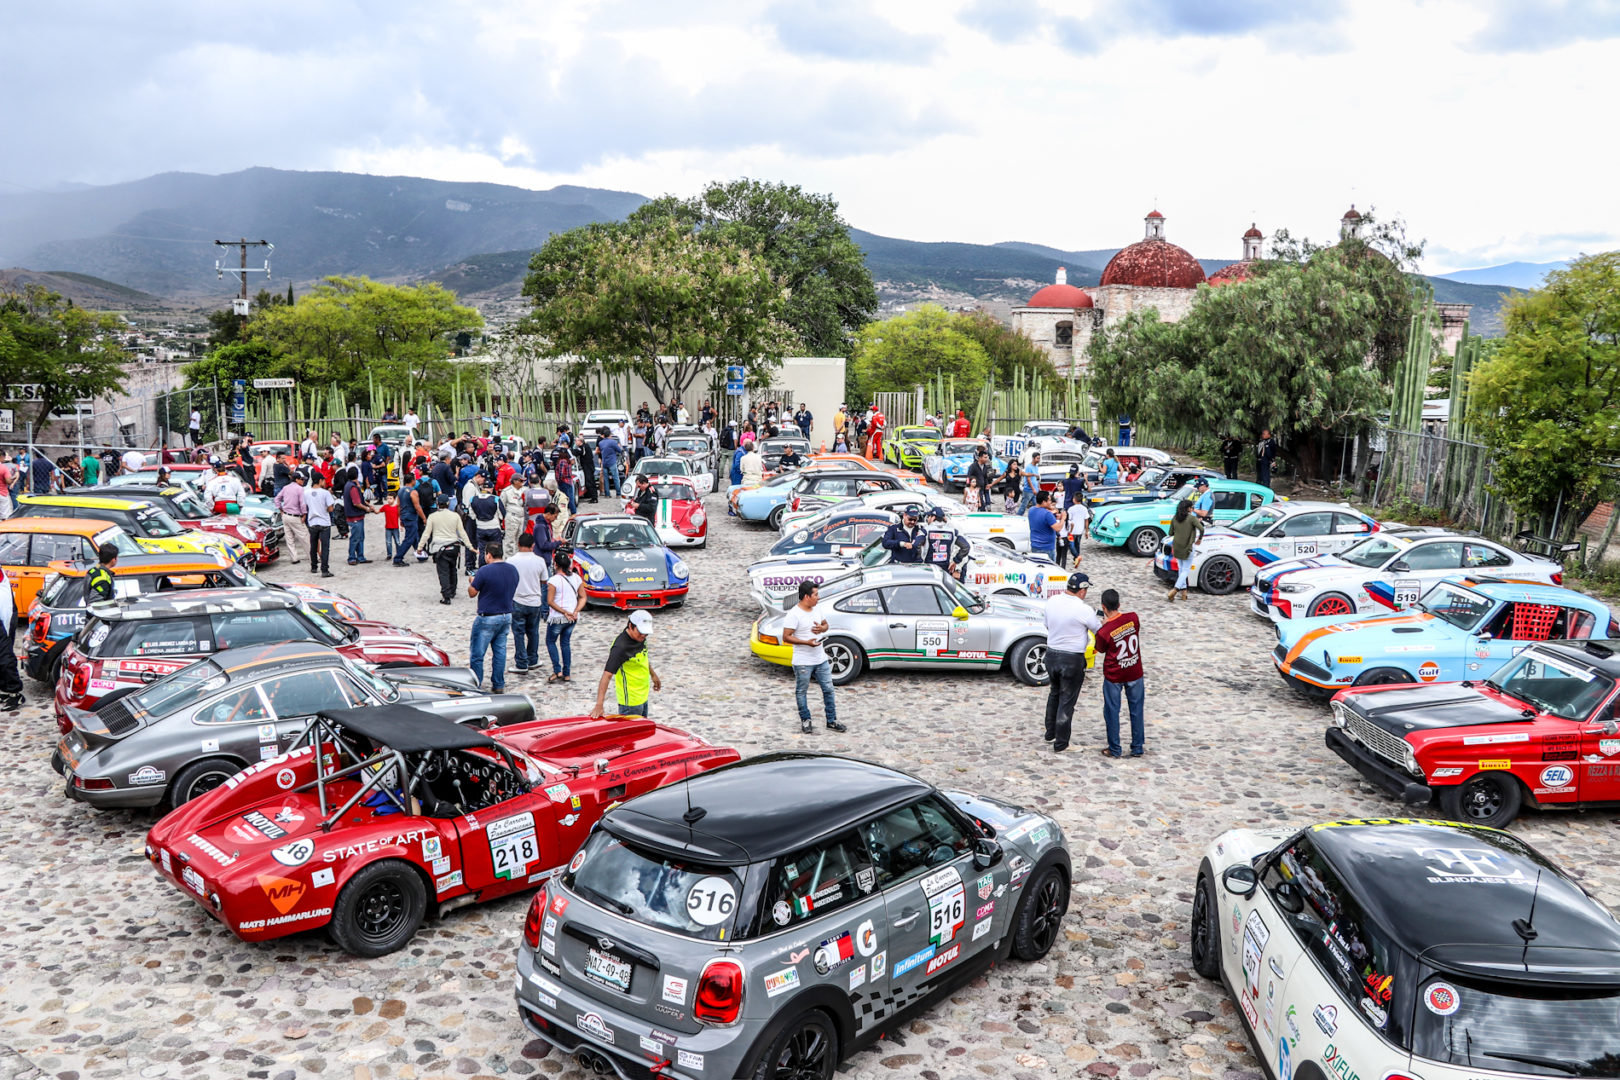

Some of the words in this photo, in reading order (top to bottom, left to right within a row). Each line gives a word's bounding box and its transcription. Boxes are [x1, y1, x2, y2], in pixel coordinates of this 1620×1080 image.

[1005, 440, 1024, 457] 119
[1297, 545, 1315, 554] 520
[975, 573, 1026, 585] DURANGO
[1396, 593, 1417, 602] 519
[922, 636, 942, 646] 550
[1115, 634, 1139, 660] 20
[1418, 668, 1440, 676] Gulf
[624, 764, 657, 777] Carrera
[1588, 765, 1608, 777] REZZA
[243, 811, 285, 840] MOTUL
[322, 840, 380, 862] STATE
[379, 836, 394, 846] OF
[395, 828, 428, 847] ART
[495, 840, 534, 869] 218
[978, 871, 993, 888] TAG
[1426, 876, 1507, 884] BLINDAJES
[267, 884, 304, 900] MH
[687, 889, 735, 915] 516
[976, 900, 995, 917] CDMX
[239, 919, 265, 929] MATS
[266, 908, 332, 926] HAMMARLUND
[933, 899, 962, 930] 516
[856, 918, 878, 957] G
[896, 949, 933, 976] infinitum
[929, 945, 959, 973] MOTUL
[655, 1003, 680, 1016] COOPER
